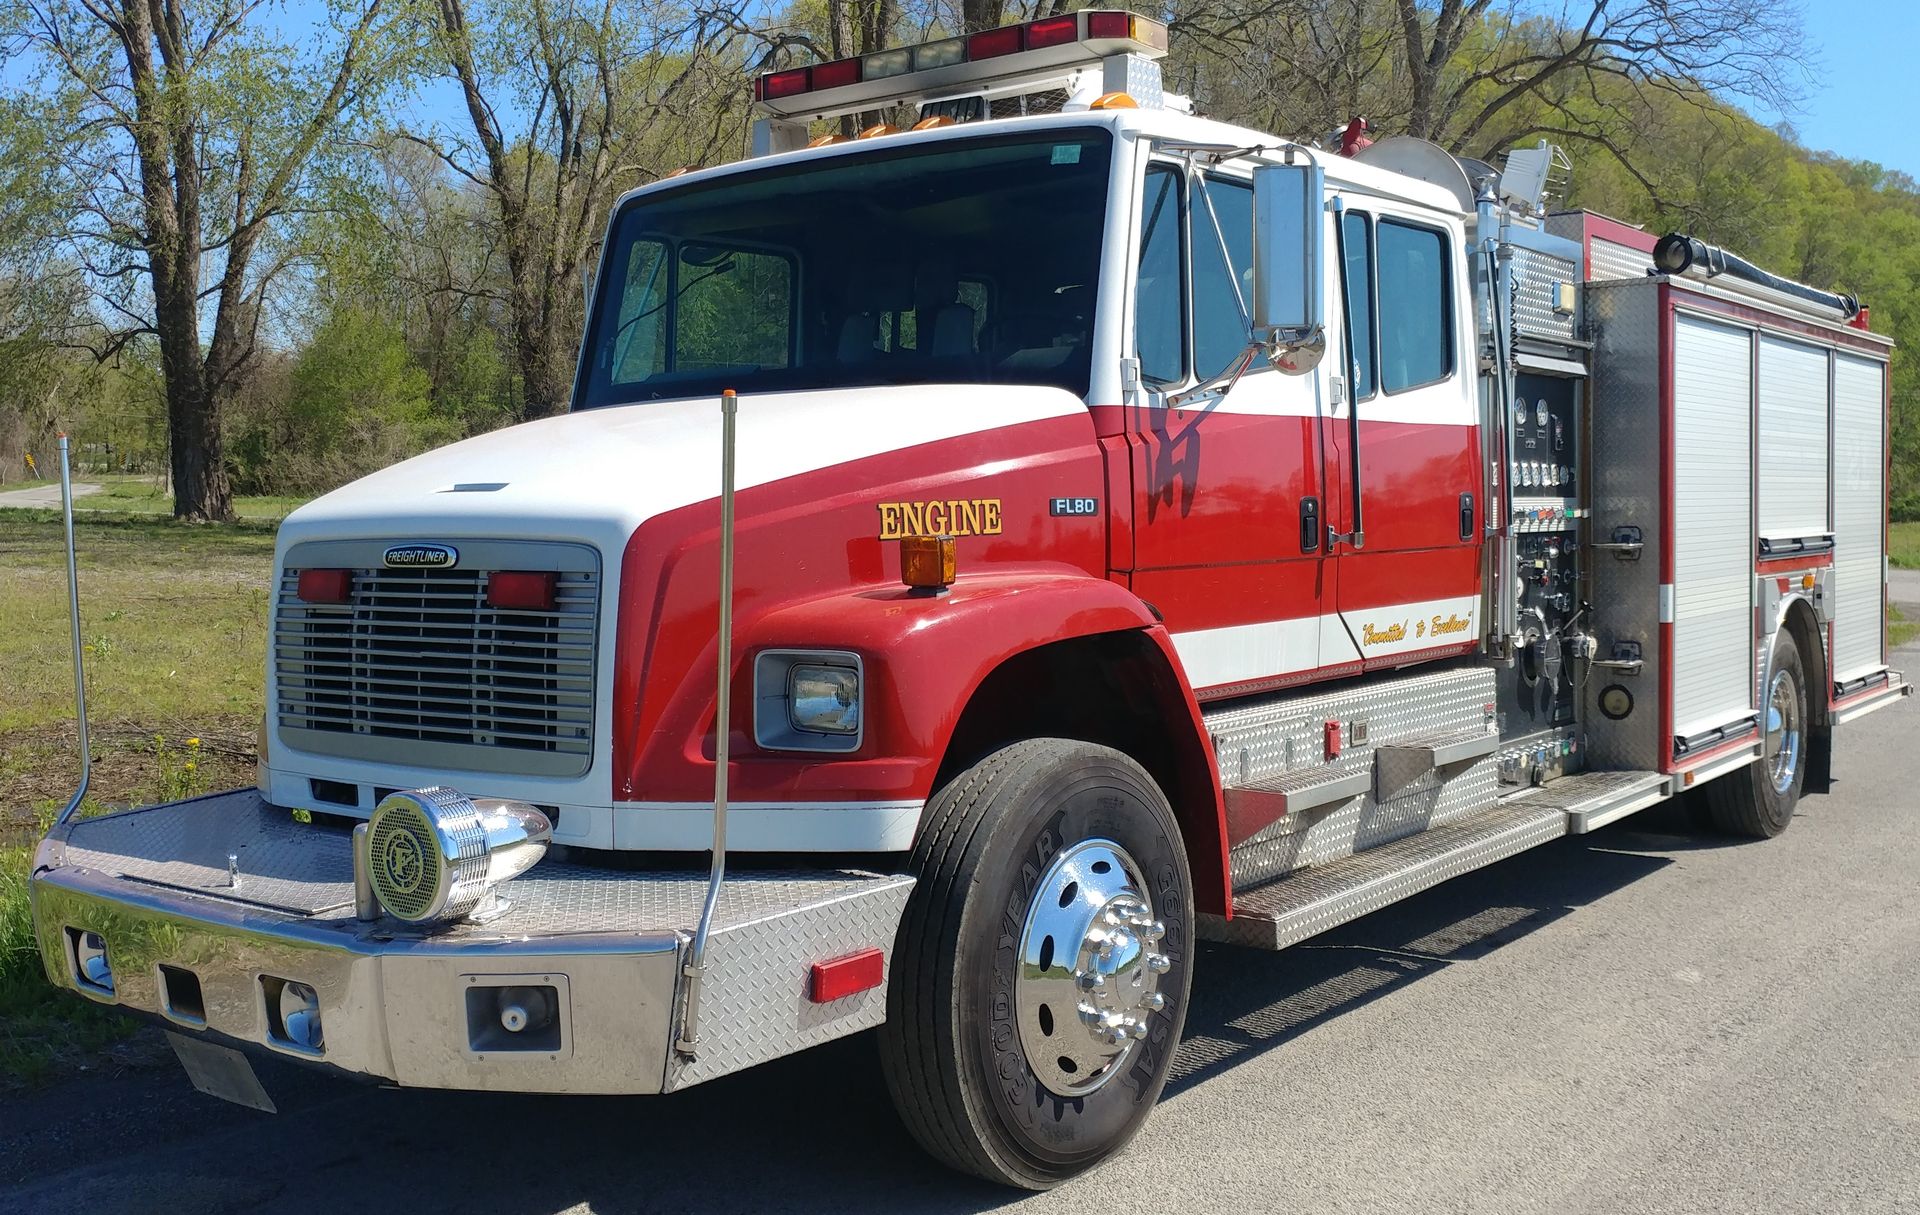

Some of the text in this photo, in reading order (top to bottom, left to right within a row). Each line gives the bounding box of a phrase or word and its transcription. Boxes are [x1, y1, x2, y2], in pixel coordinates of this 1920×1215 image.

[877, 499, 1003, 540] ENGINE
[1056, 499, 1095, 514] FL80
[387, 550, 446, 562] FREIGHTLINER
[993, 829, 1059, 1107] GOODYEAR
